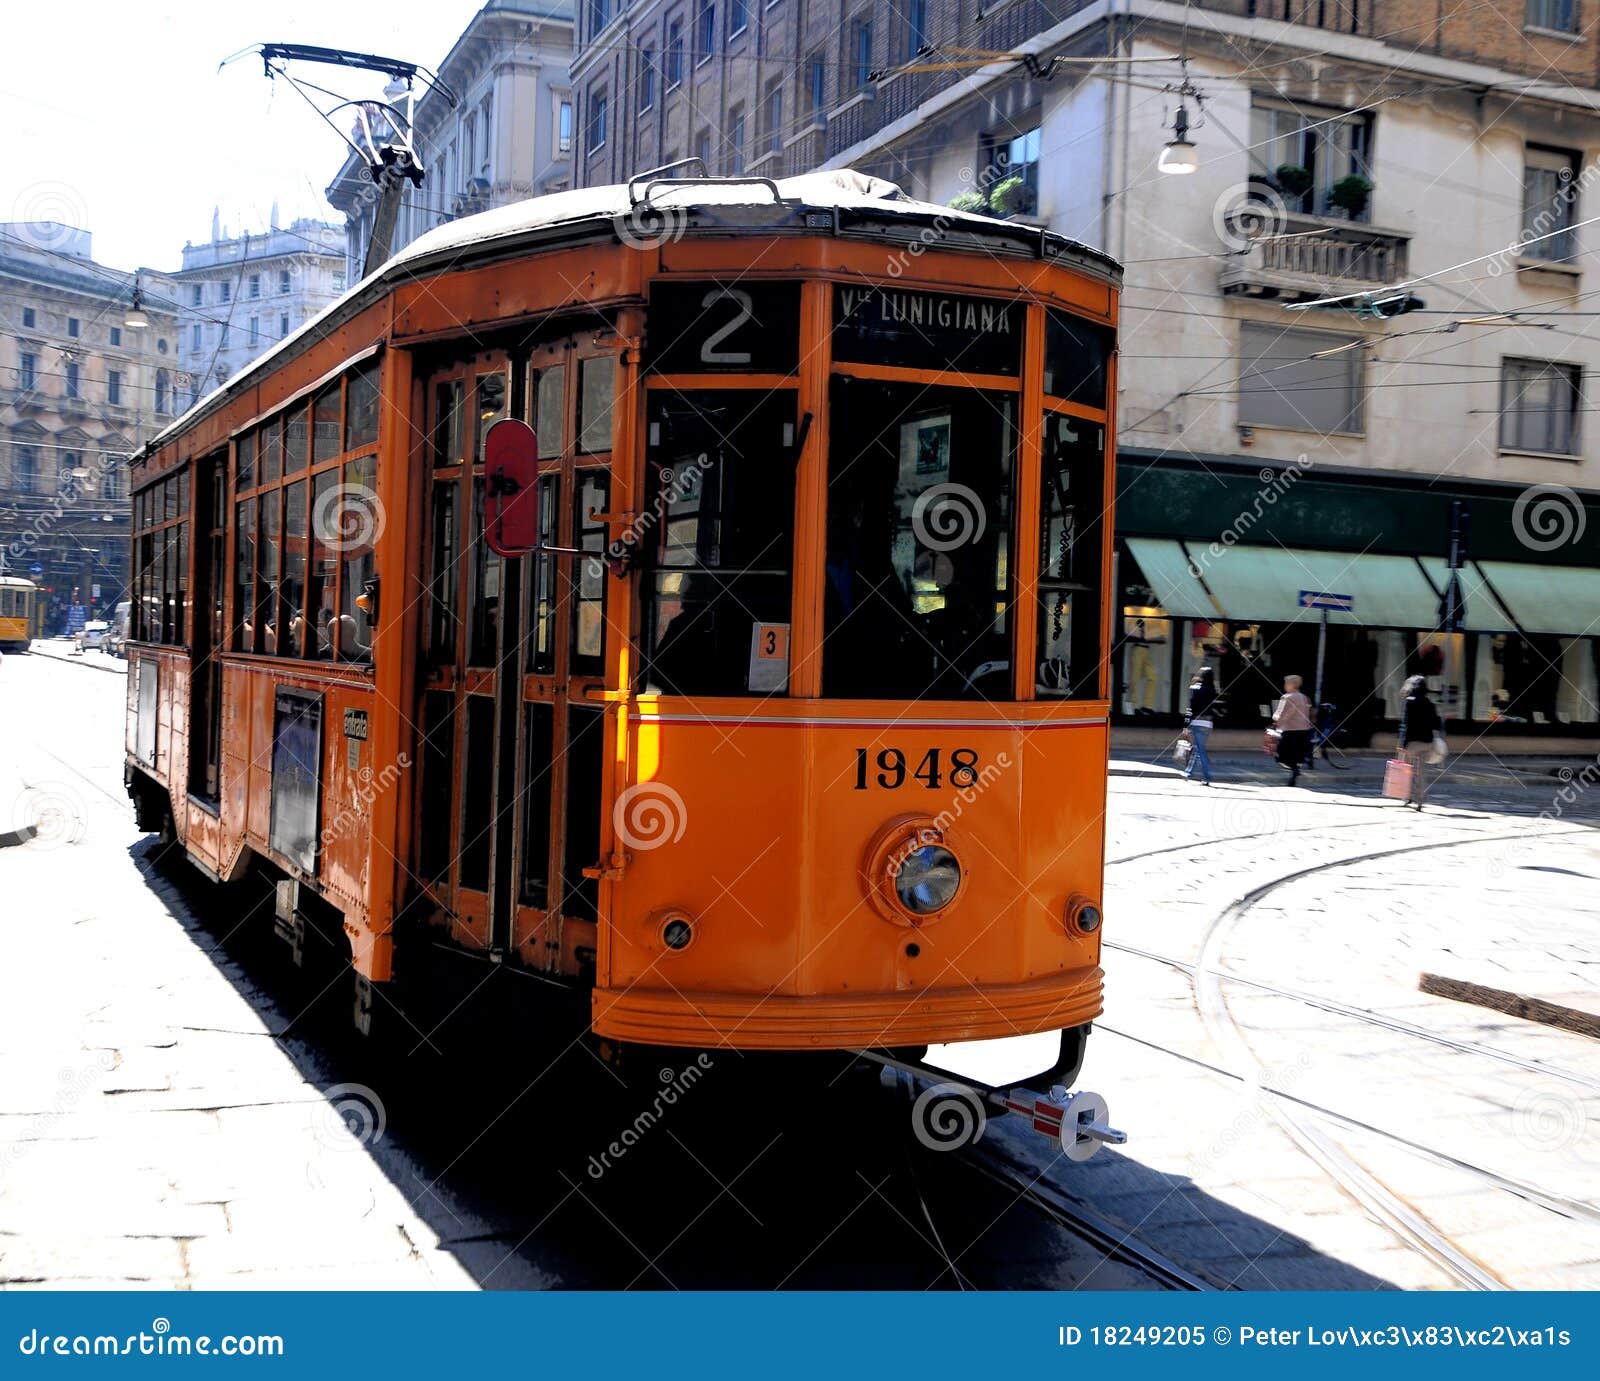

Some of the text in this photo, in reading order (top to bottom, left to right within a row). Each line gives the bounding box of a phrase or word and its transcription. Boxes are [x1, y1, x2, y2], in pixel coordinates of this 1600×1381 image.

[700, 288, 754, 364] 2
[881, 292, 1011, 335] LUNIGIANA
[765, 630, 777, 655] 3
[853, 747, 979, 790] 1948
